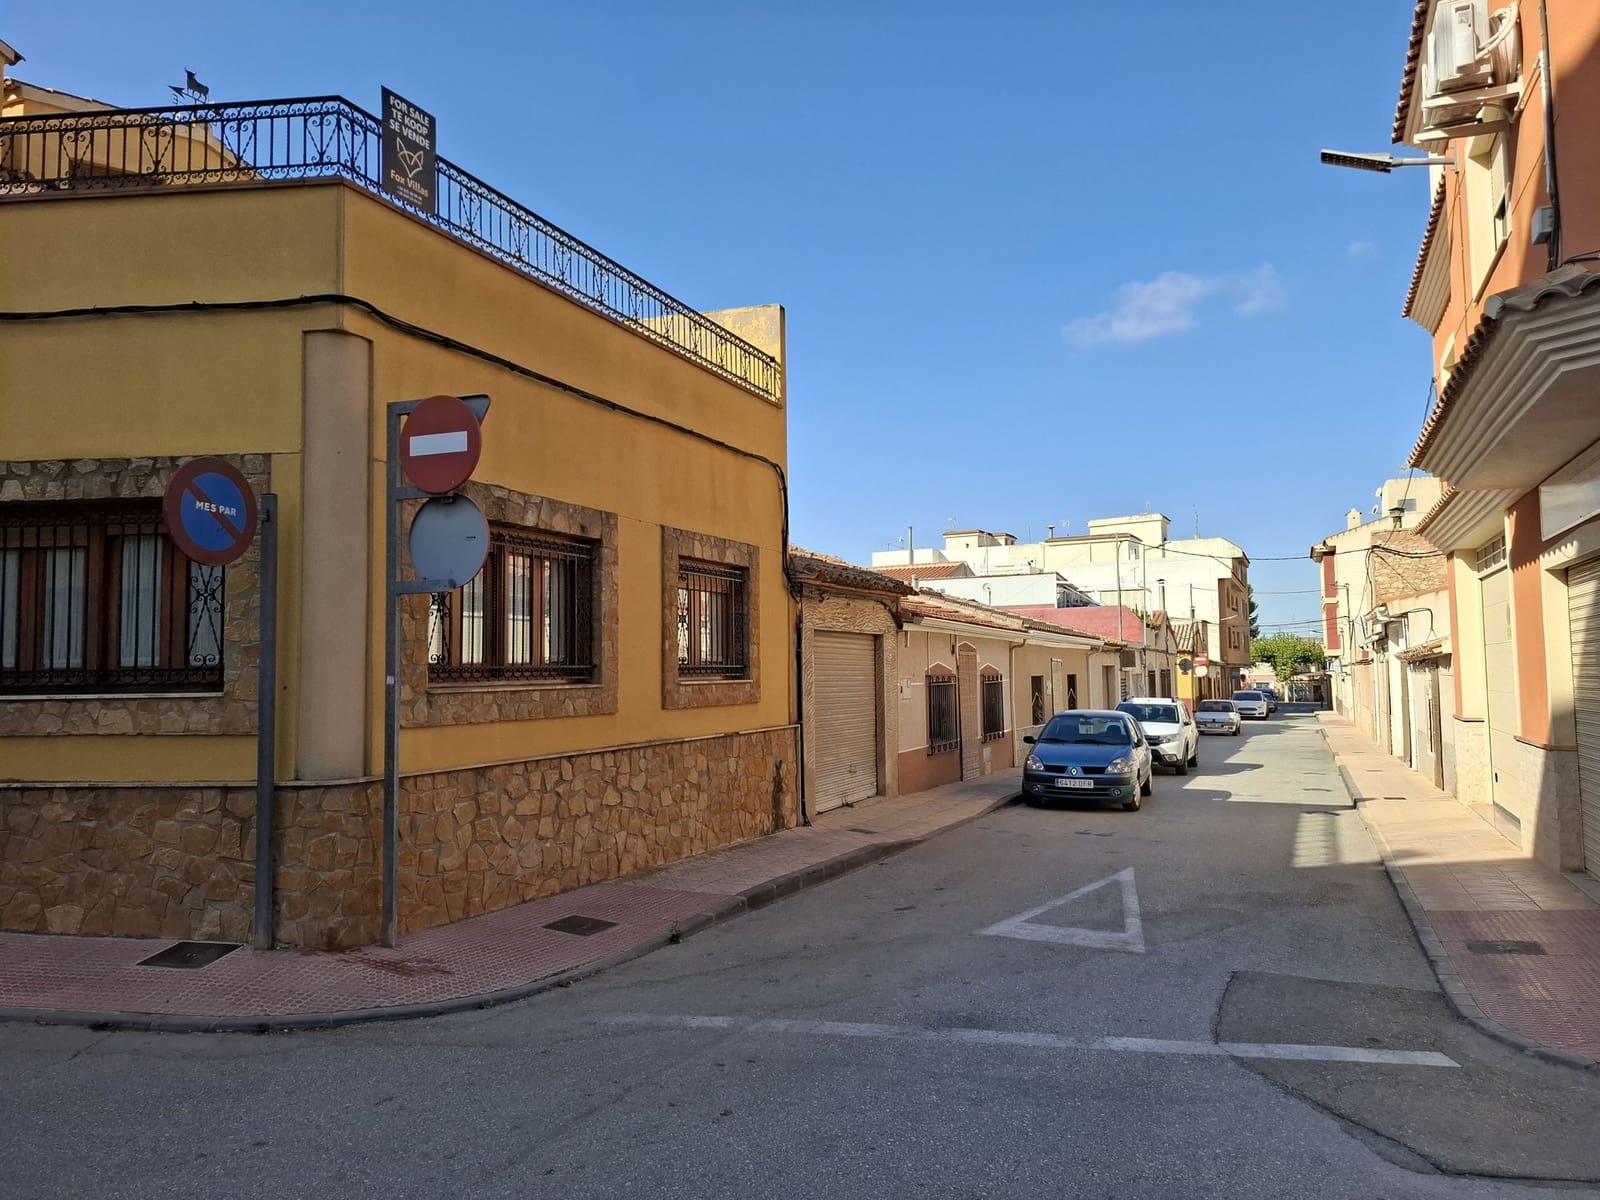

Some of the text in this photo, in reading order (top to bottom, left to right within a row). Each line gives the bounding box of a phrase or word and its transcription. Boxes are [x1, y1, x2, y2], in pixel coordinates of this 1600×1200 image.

[390, 95, 429, 127] FOR SALE
[391, 107, 428, 136] TE KOOP
[389, 119, 430, 150] SE VENDE
[390, 169, 405, 185] Fox
[195, 501, 237, 517] MES PAR
